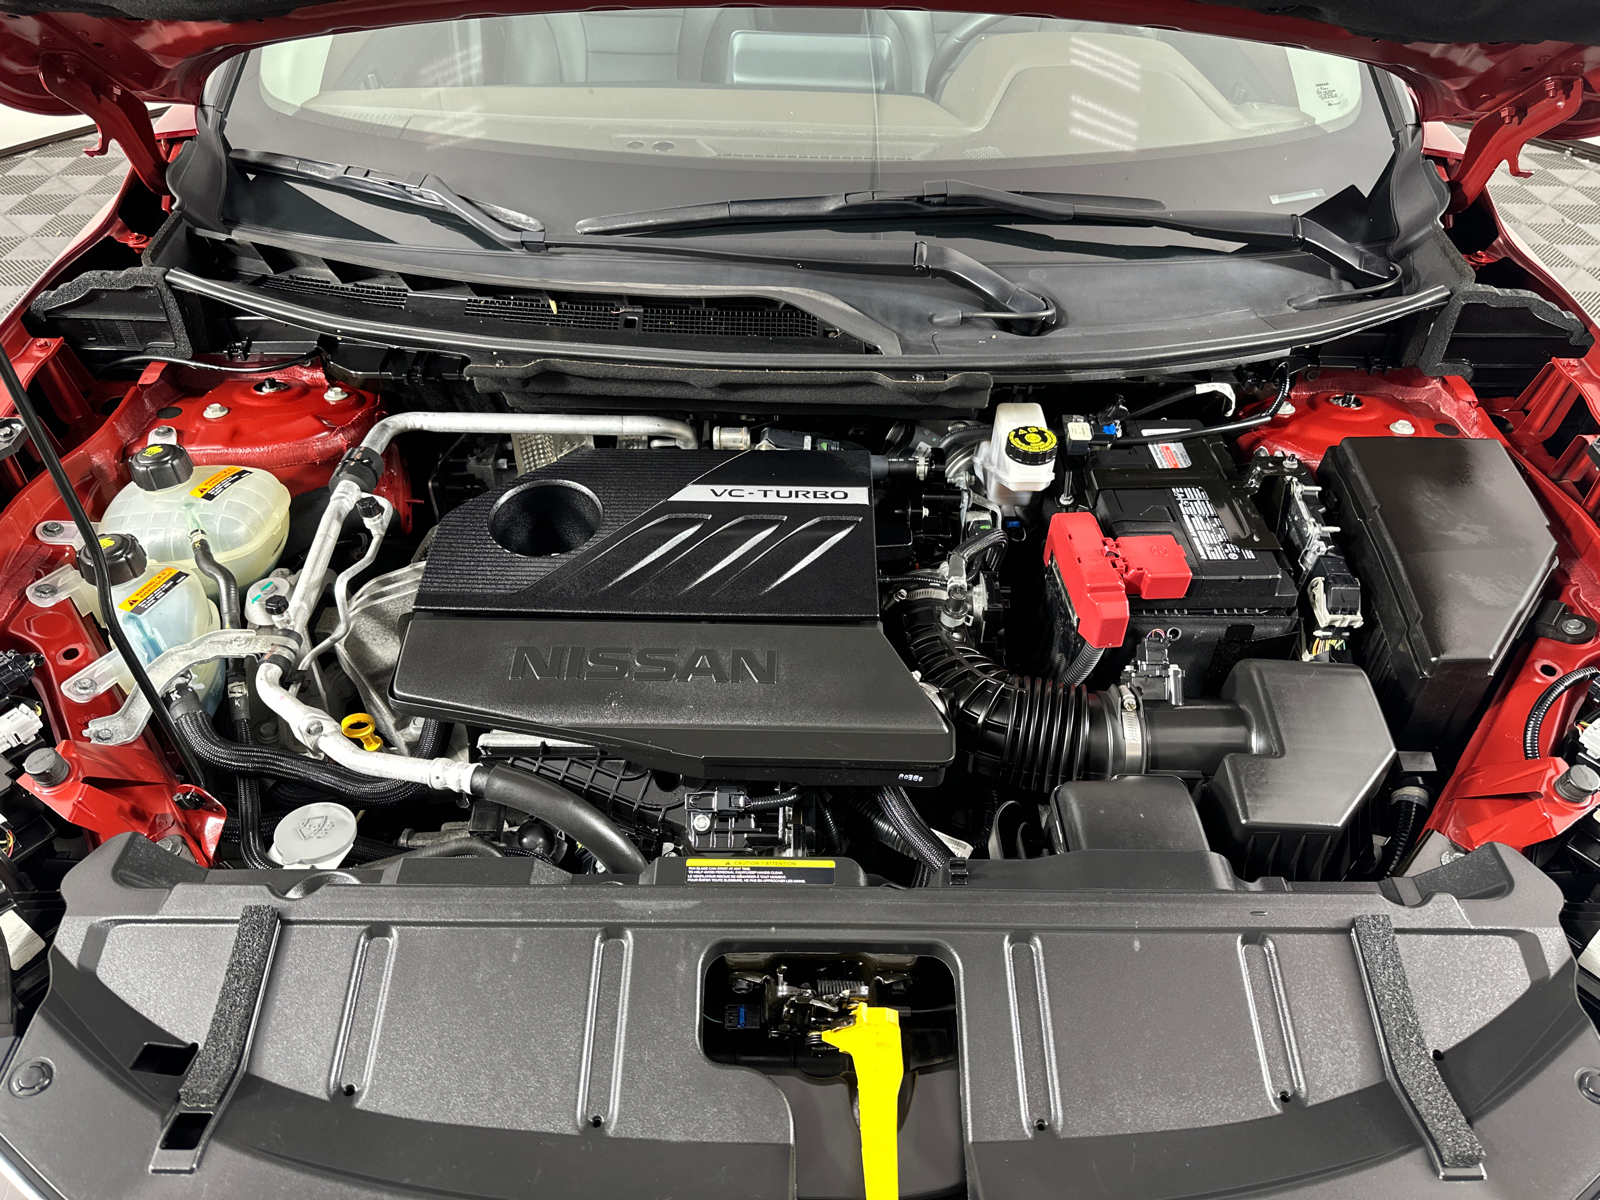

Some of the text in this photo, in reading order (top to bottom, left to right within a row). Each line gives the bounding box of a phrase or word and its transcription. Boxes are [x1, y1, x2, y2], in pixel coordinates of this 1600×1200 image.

[710, 488, 848, 500] VC-TURBO
[508, 645, 778, 684] NISSAN
[170, 690, 181, 701] K
